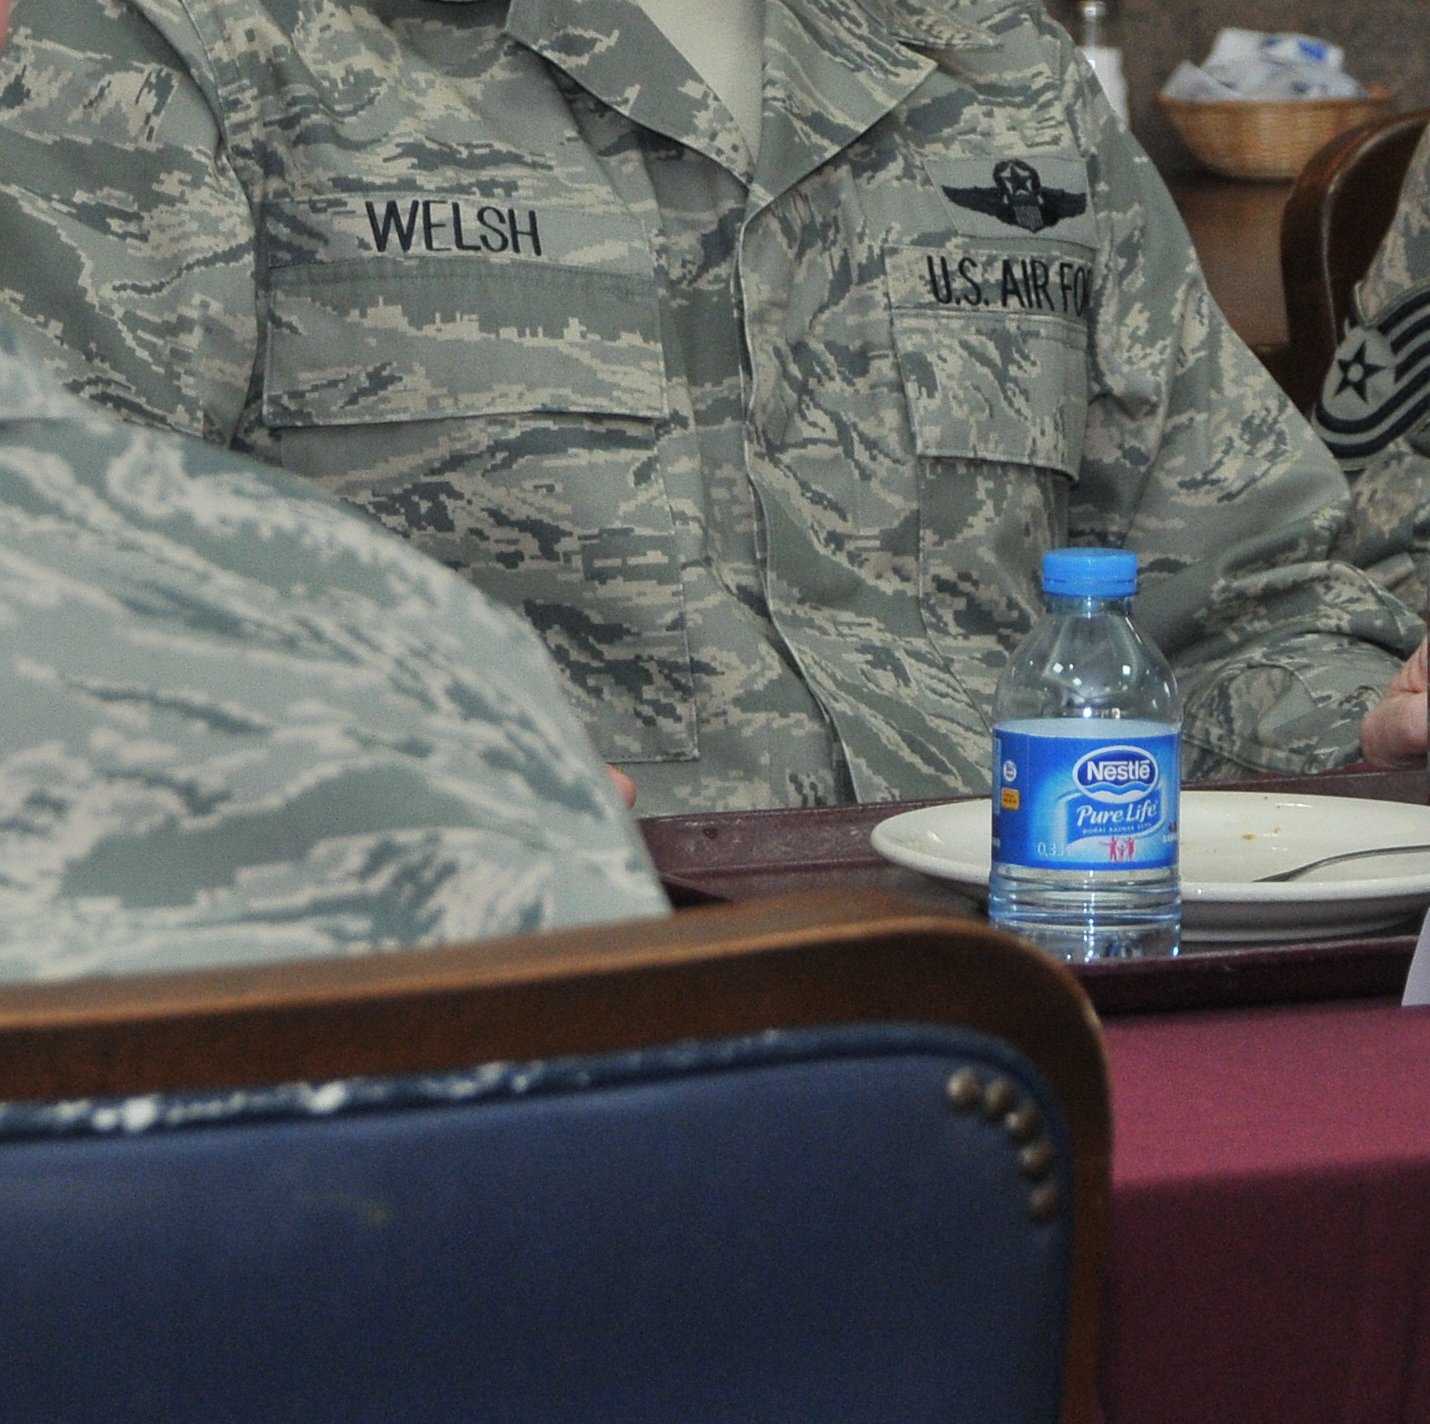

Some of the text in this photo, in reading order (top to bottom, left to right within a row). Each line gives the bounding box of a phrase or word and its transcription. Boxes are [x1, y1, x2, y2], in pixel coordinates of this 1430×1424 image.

[365, 199, 542, 256] WELSH
[926, 255, 989, 306] U.S.
[1001, 258, 1056, 311] AIR
[1077, 800, 1157, 826] Pure Life
